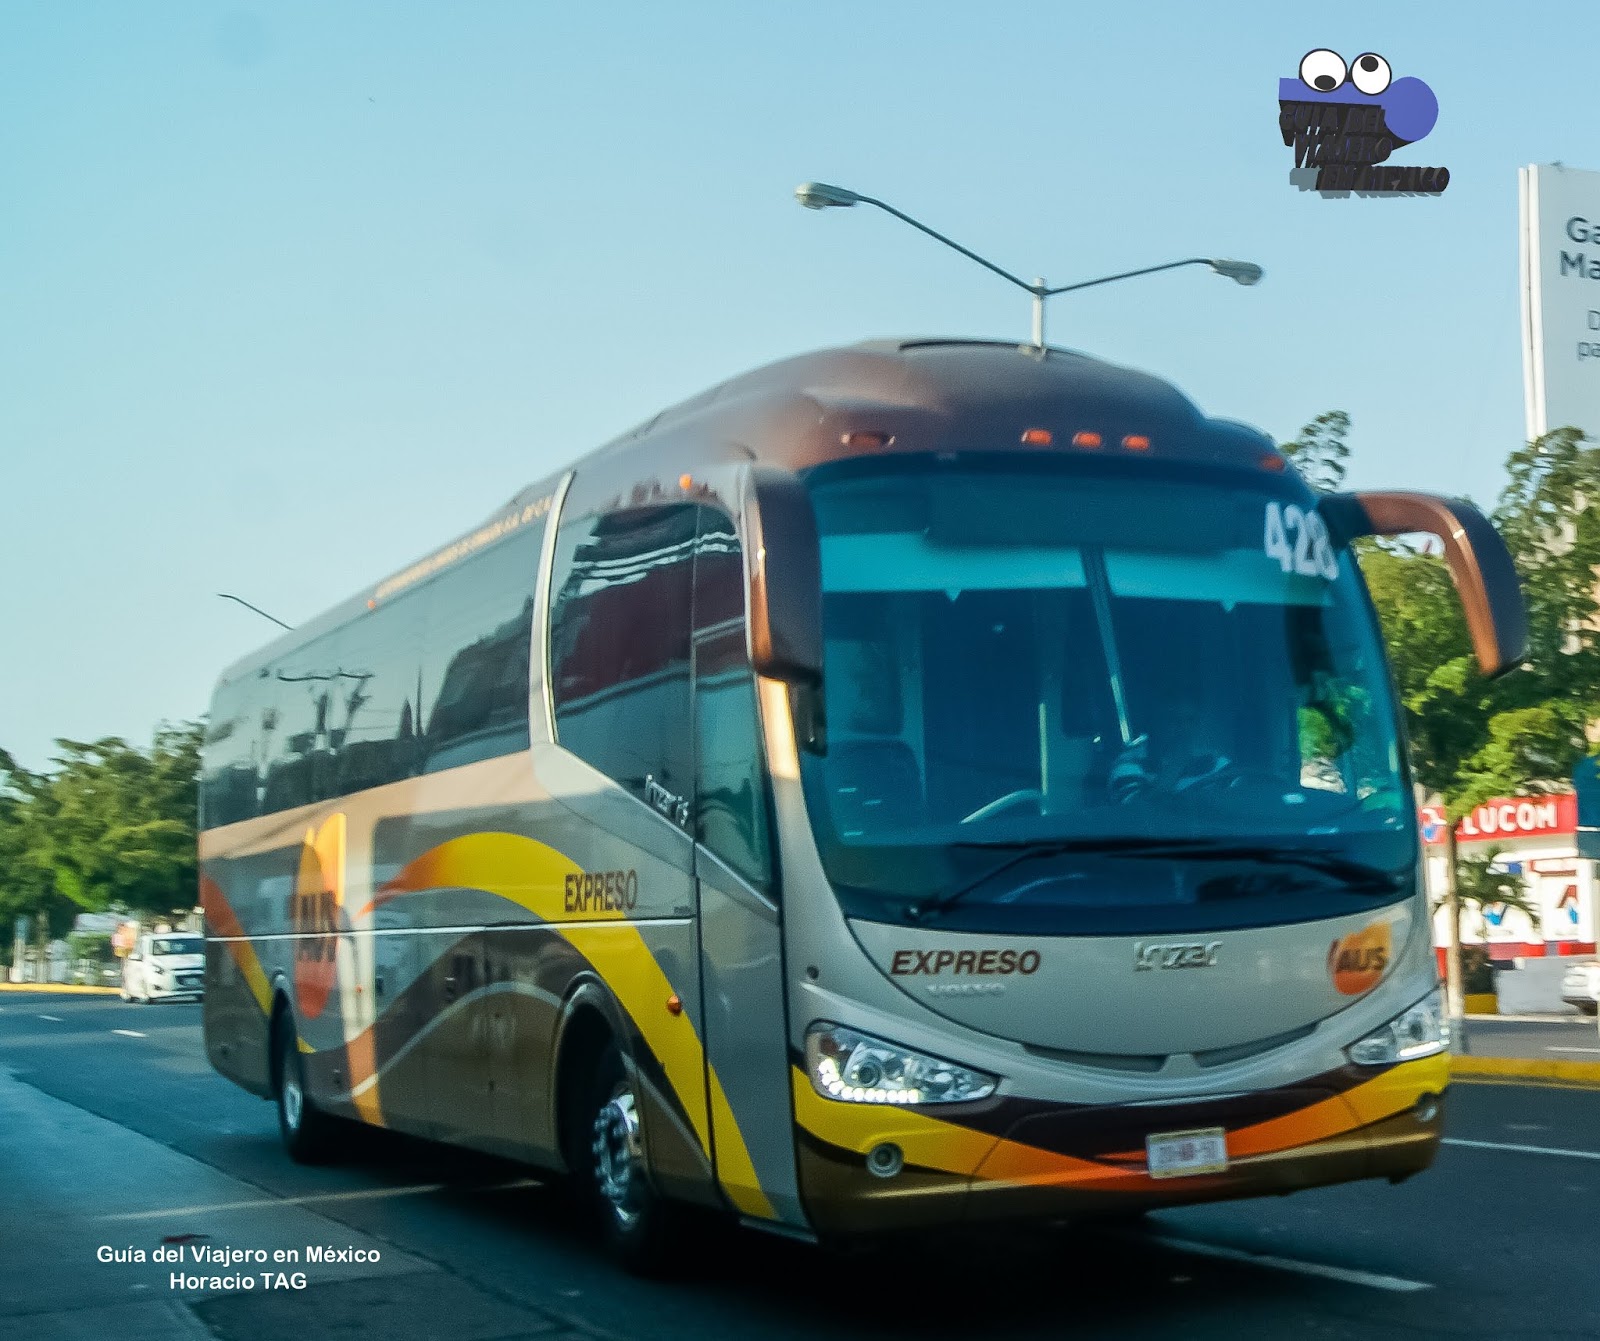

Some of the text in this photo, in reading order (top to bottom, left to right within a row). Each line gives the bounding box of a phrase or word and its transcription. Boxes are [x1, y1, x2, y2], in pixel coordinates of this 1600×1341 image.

[1264, 501, 1339, 580] 428
[1458, 802, 1558, 836] LUCOM
[564, 869, 638, 913] EXPRESO
[890, 949, 1042, 975] EXPRESO
